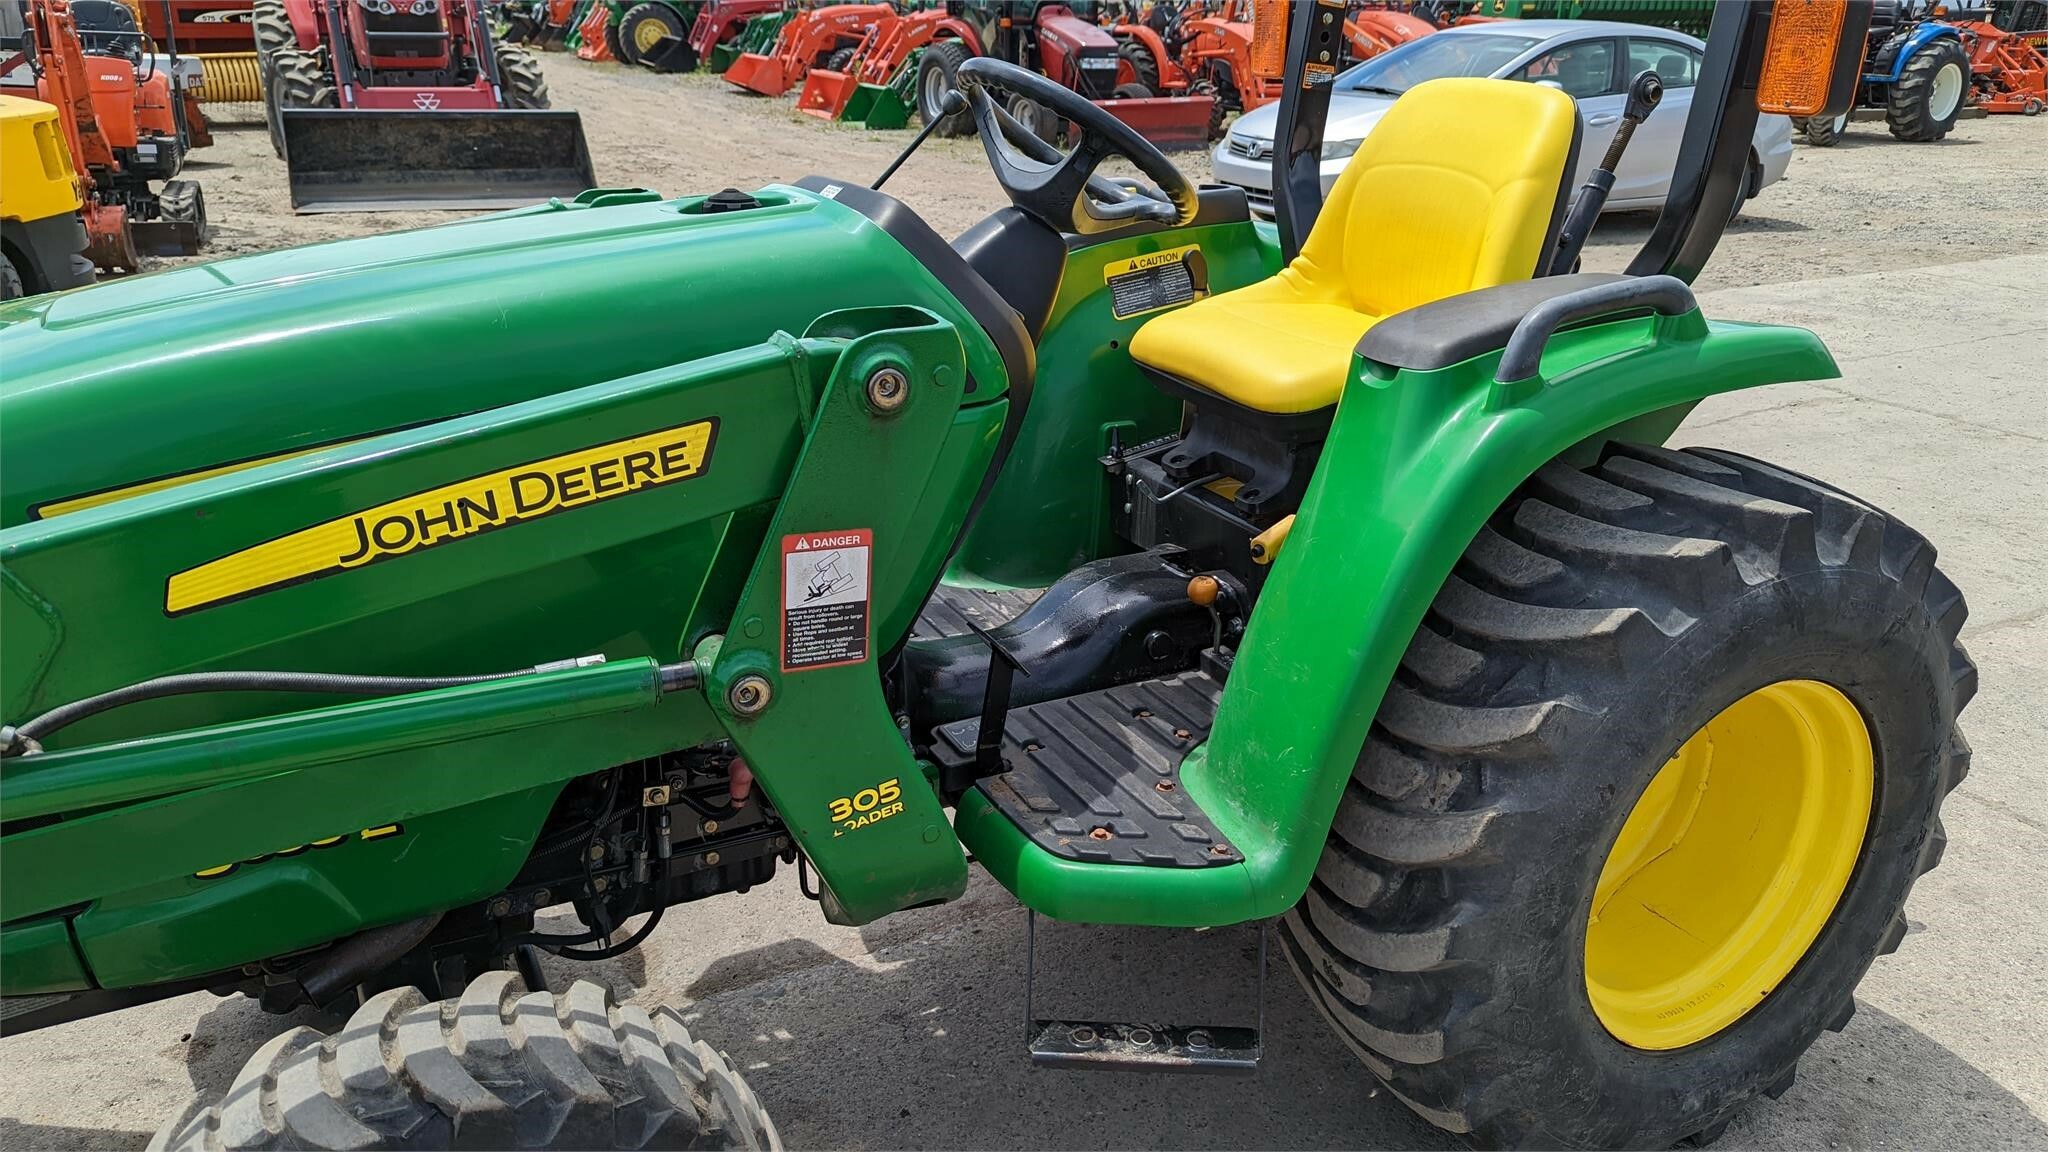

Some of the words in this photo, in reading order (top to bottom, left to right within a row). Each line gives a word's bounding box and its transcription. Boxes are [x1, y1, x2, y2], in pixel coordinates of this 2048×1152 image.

[1139, 252, 1179, 268] CAUTION
[341, 488, 500, 565] JOHN
[509, 440, 691, 514] DEERE
[813, 535, 861, 548] DANGER
[829, 777, 902, 823] 305
